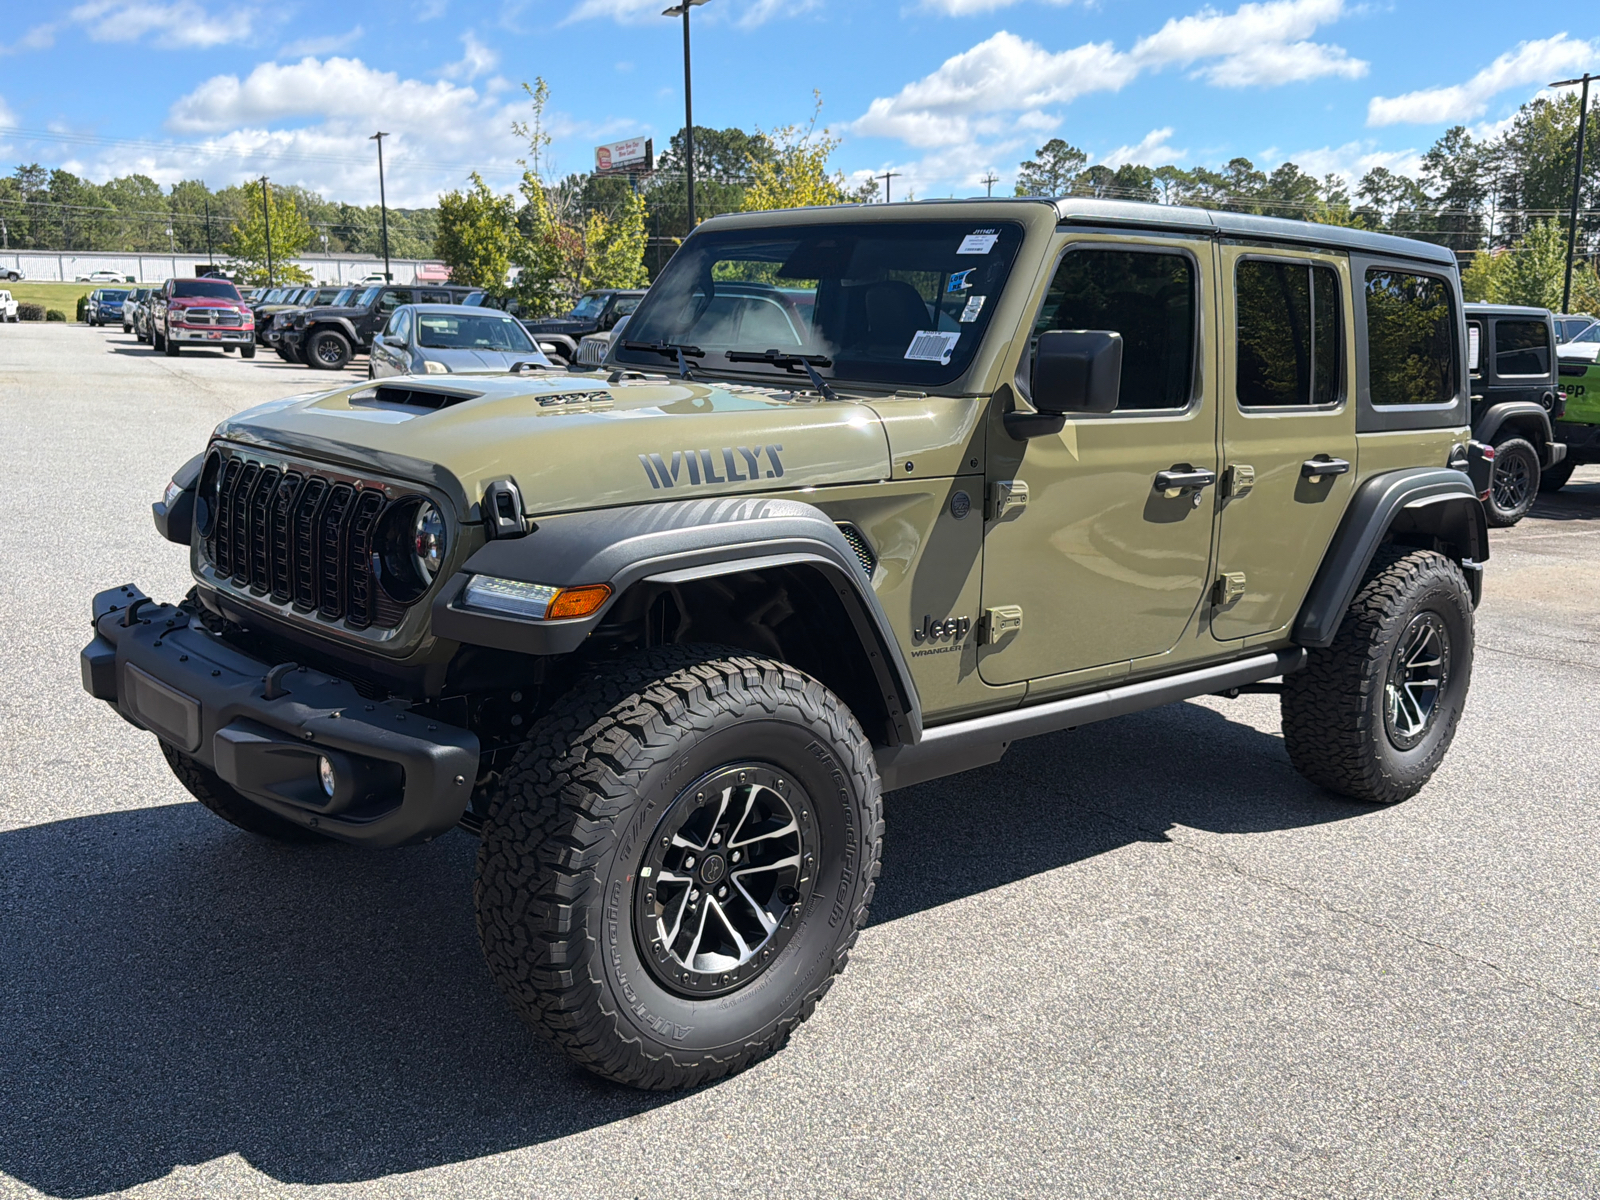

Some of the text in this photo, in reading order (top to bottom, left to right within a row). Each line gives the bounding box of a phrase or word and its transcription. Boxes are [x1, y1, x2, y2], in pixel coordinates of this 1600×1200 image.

[534, 391, 614, 407] 392
[1558, 383, 1585, 398] eep
[638, 443, 784, 489] WILLYS
[914, 614, 970, 641] Jeep
[910, 644, 962, 658] WRANGLER
[804, 740, 856, 928] BFGoodrich
[607, 879, 695, 1041] All-Terrain
